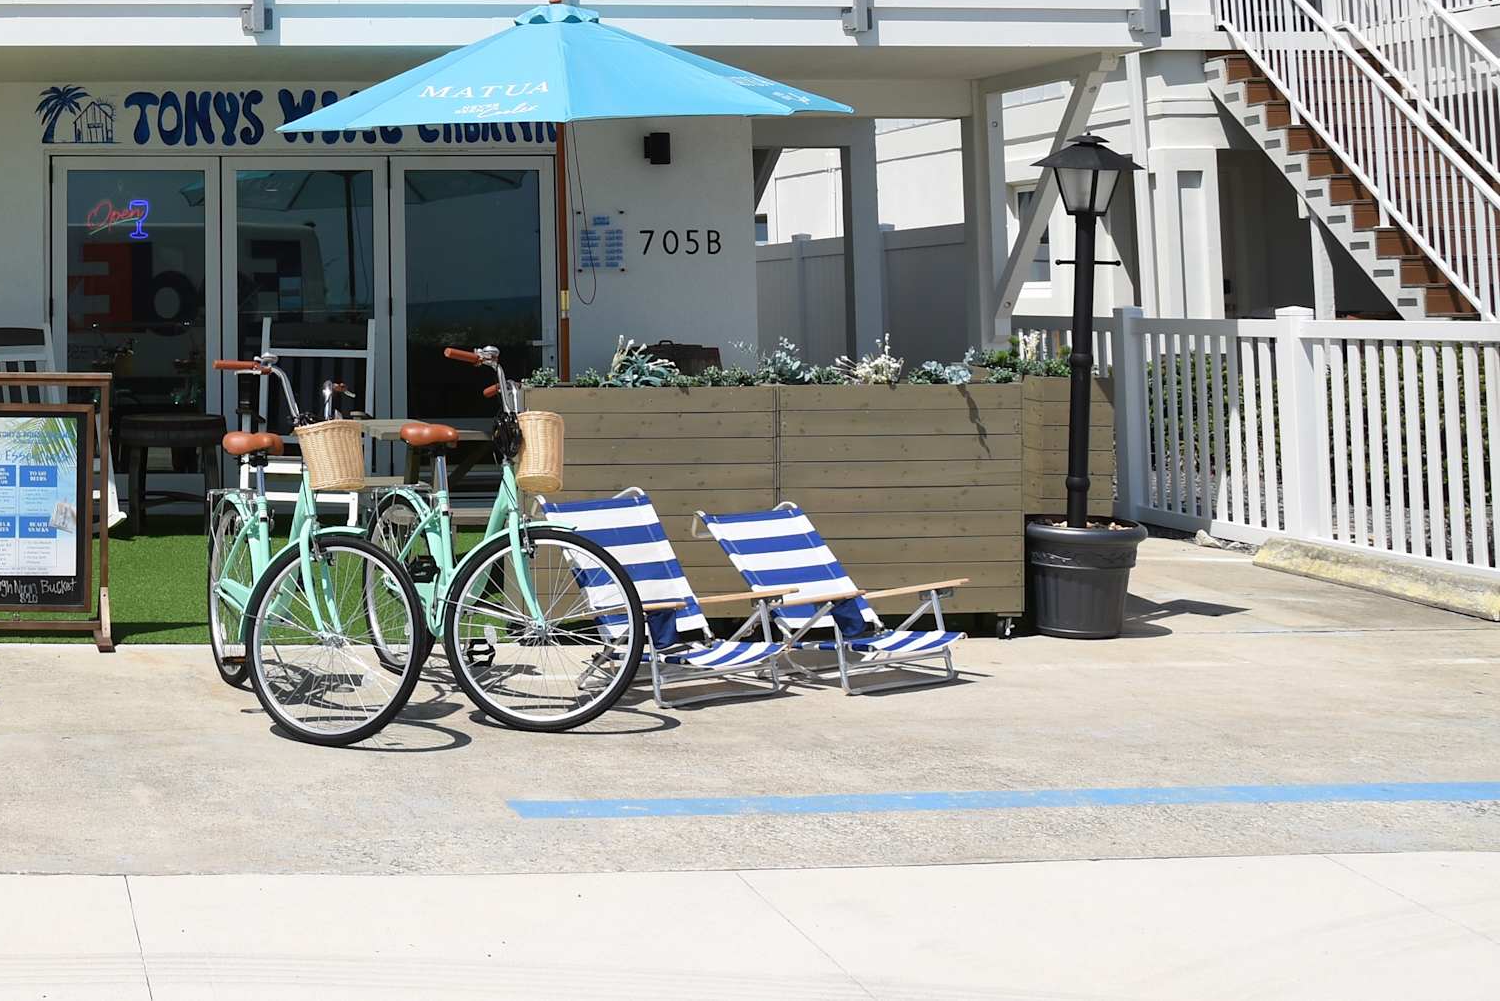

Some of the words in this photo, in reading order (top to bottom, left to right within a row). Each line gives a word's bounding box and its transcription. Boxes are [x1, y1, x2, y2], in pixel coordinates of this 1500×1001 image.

[418, 81, 549, 98] MATUA
[124, 89, 264, 146] TONY'S
[86, 199, 144, 232] Open
[639, 229, 722, 255] 705B
[40, 577, 78, 595] Bucket
